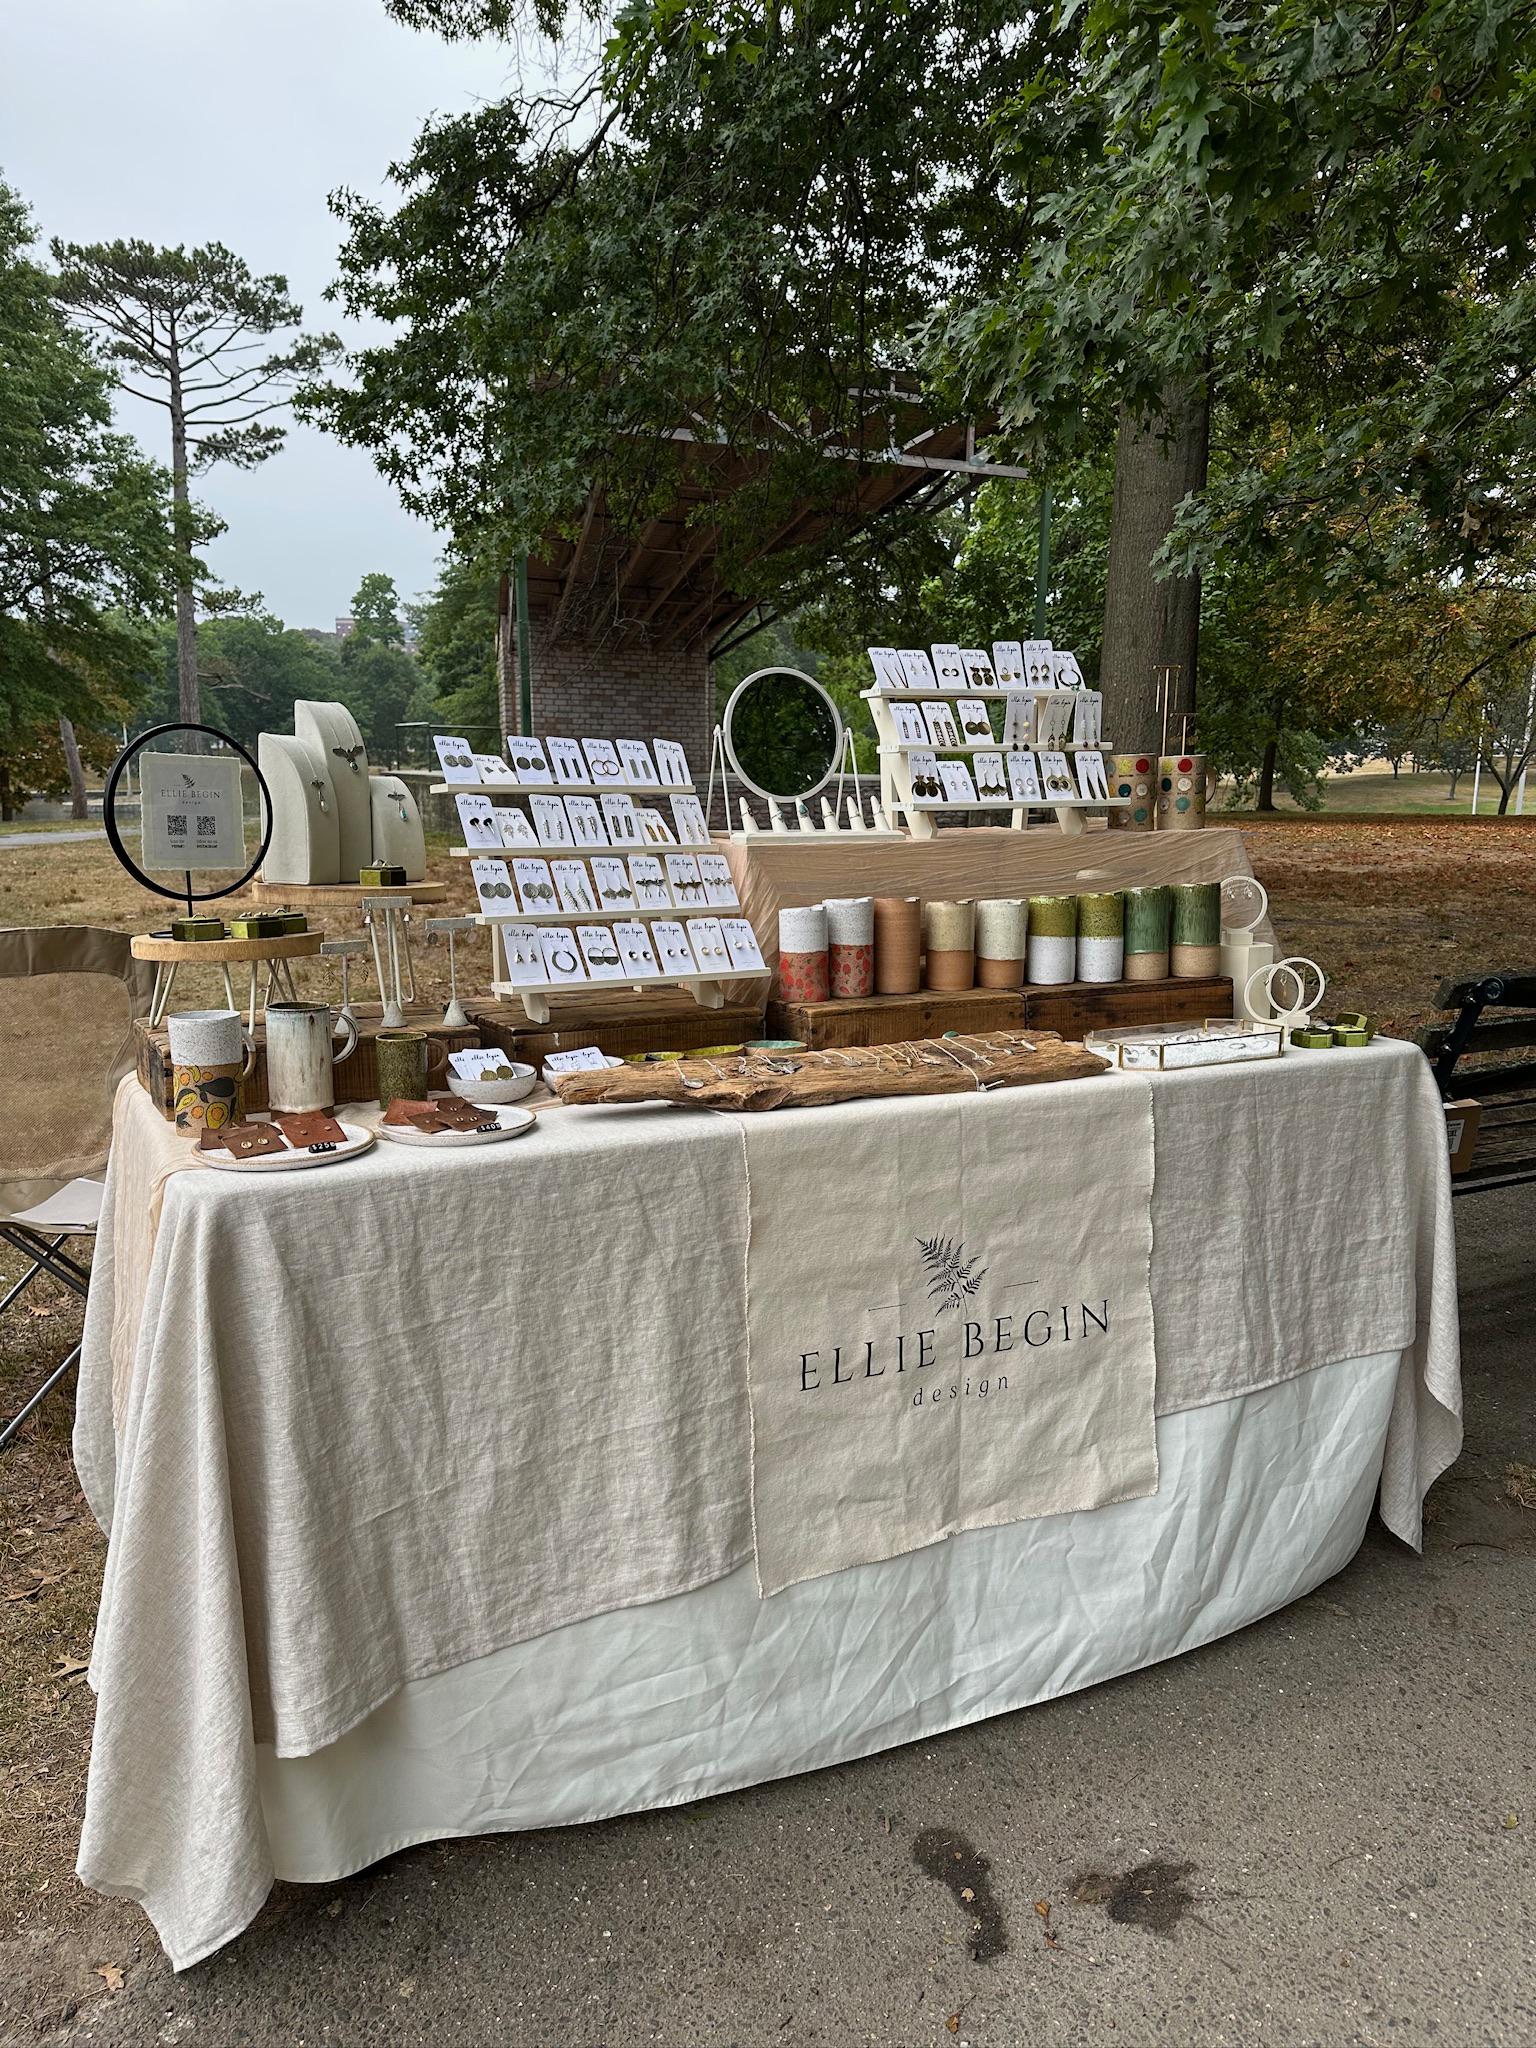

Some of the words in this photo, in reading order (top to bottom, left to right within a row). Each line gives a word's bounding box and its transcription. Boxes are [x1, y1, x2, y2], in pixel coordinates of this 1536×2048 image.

[161, 790, 186, 798] ELLIE
[192, 790, 220, 798] BEGIN
[799, 1329, 937, 1392] ELLIE
[962, 1299, 1110, 1359] BEGIN
[912, 1375, 1010, 1407] design
